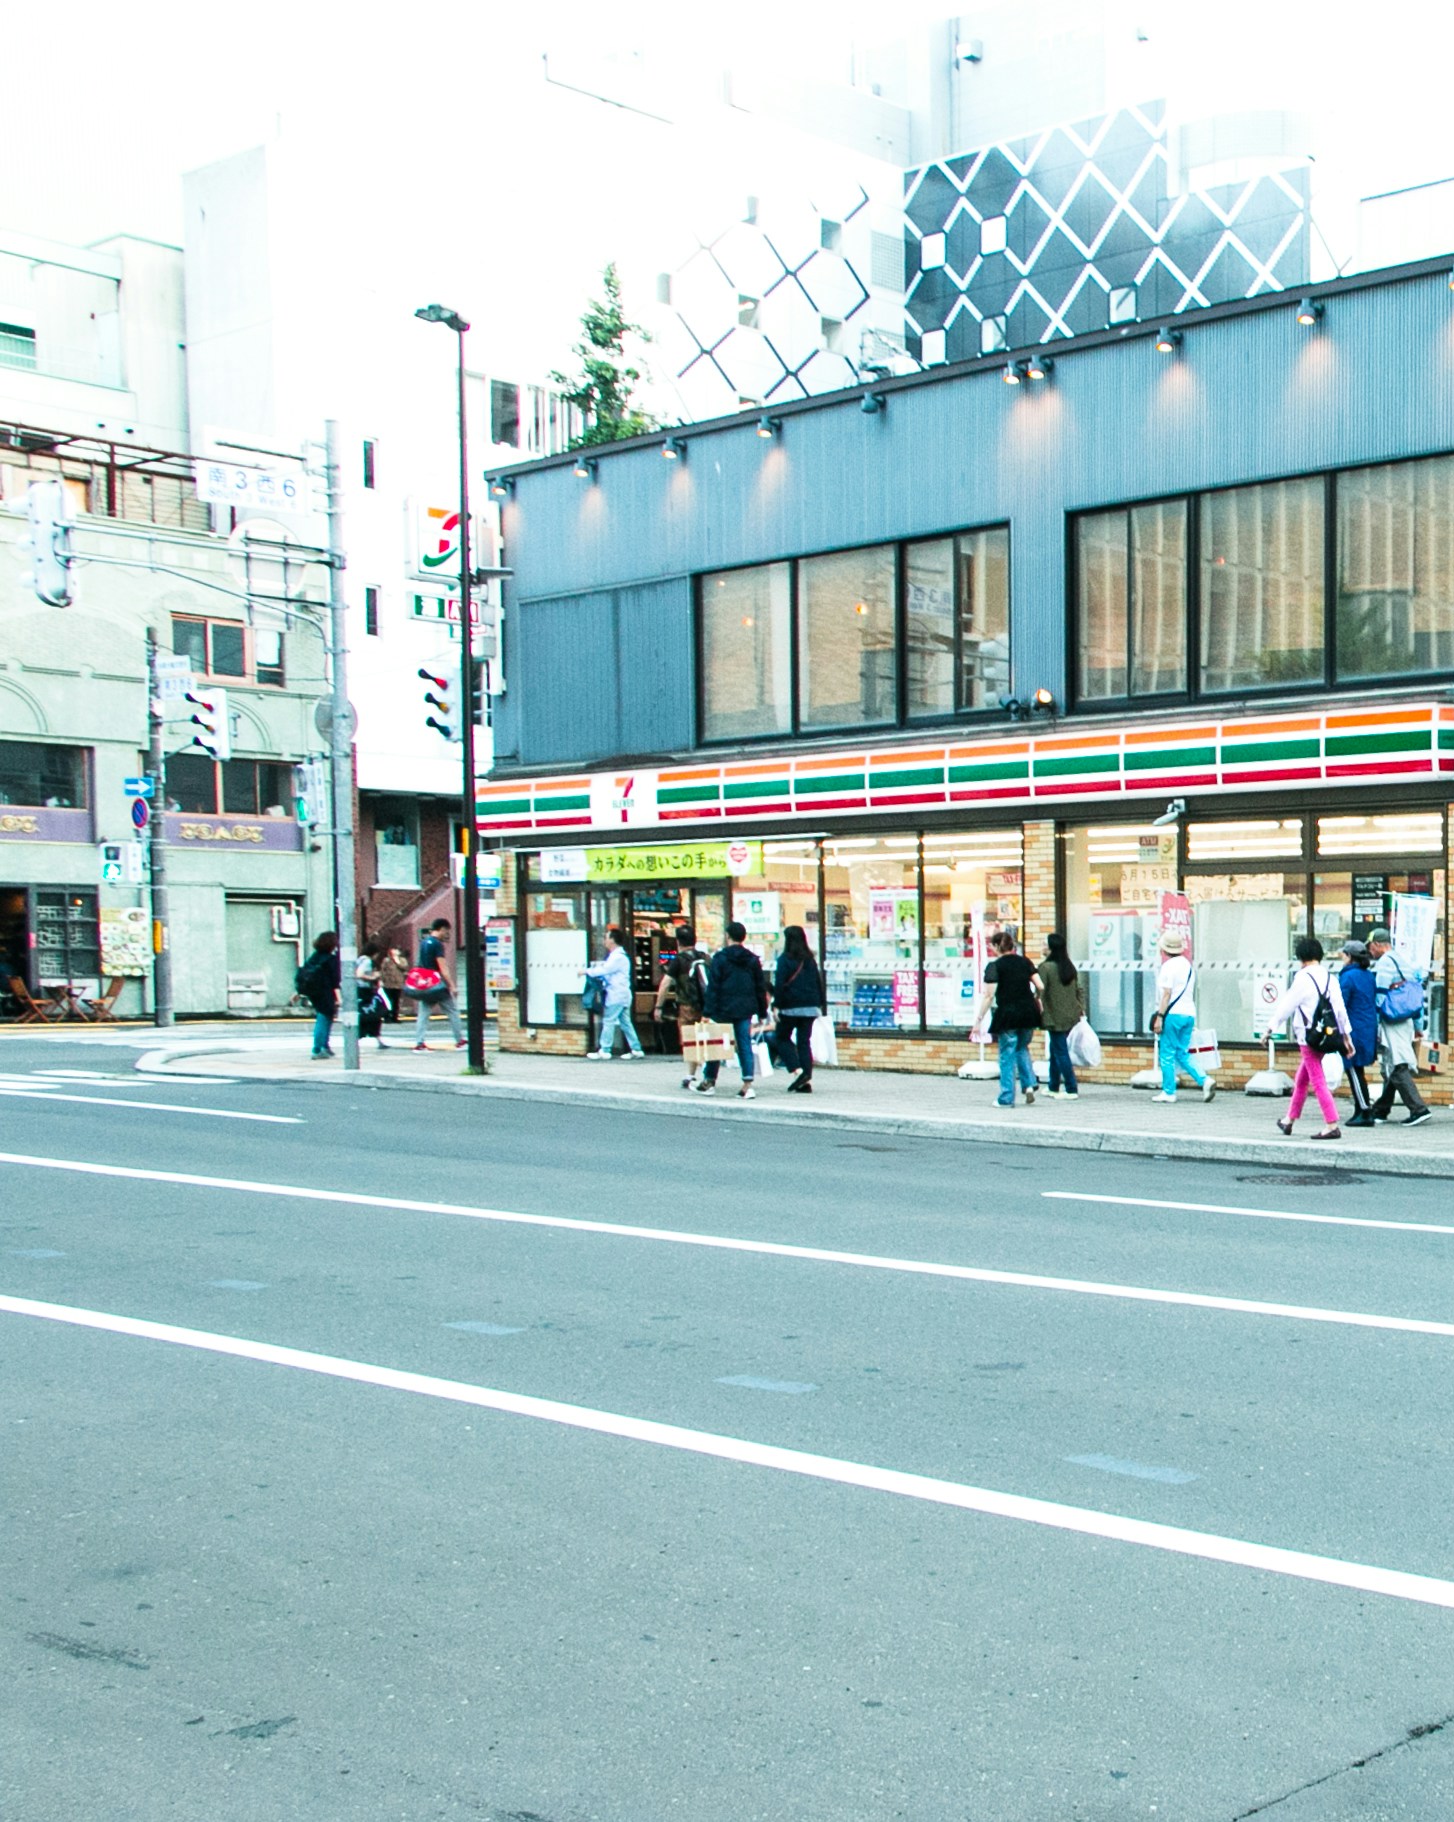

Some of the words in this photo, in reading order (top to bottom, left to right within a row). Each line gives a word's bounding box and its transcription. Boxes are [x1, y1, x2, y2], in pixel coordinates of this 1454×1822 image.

[615, 776, 634, 822] 7
[593, 852, 727, 873] カラダへの想いこの手から
